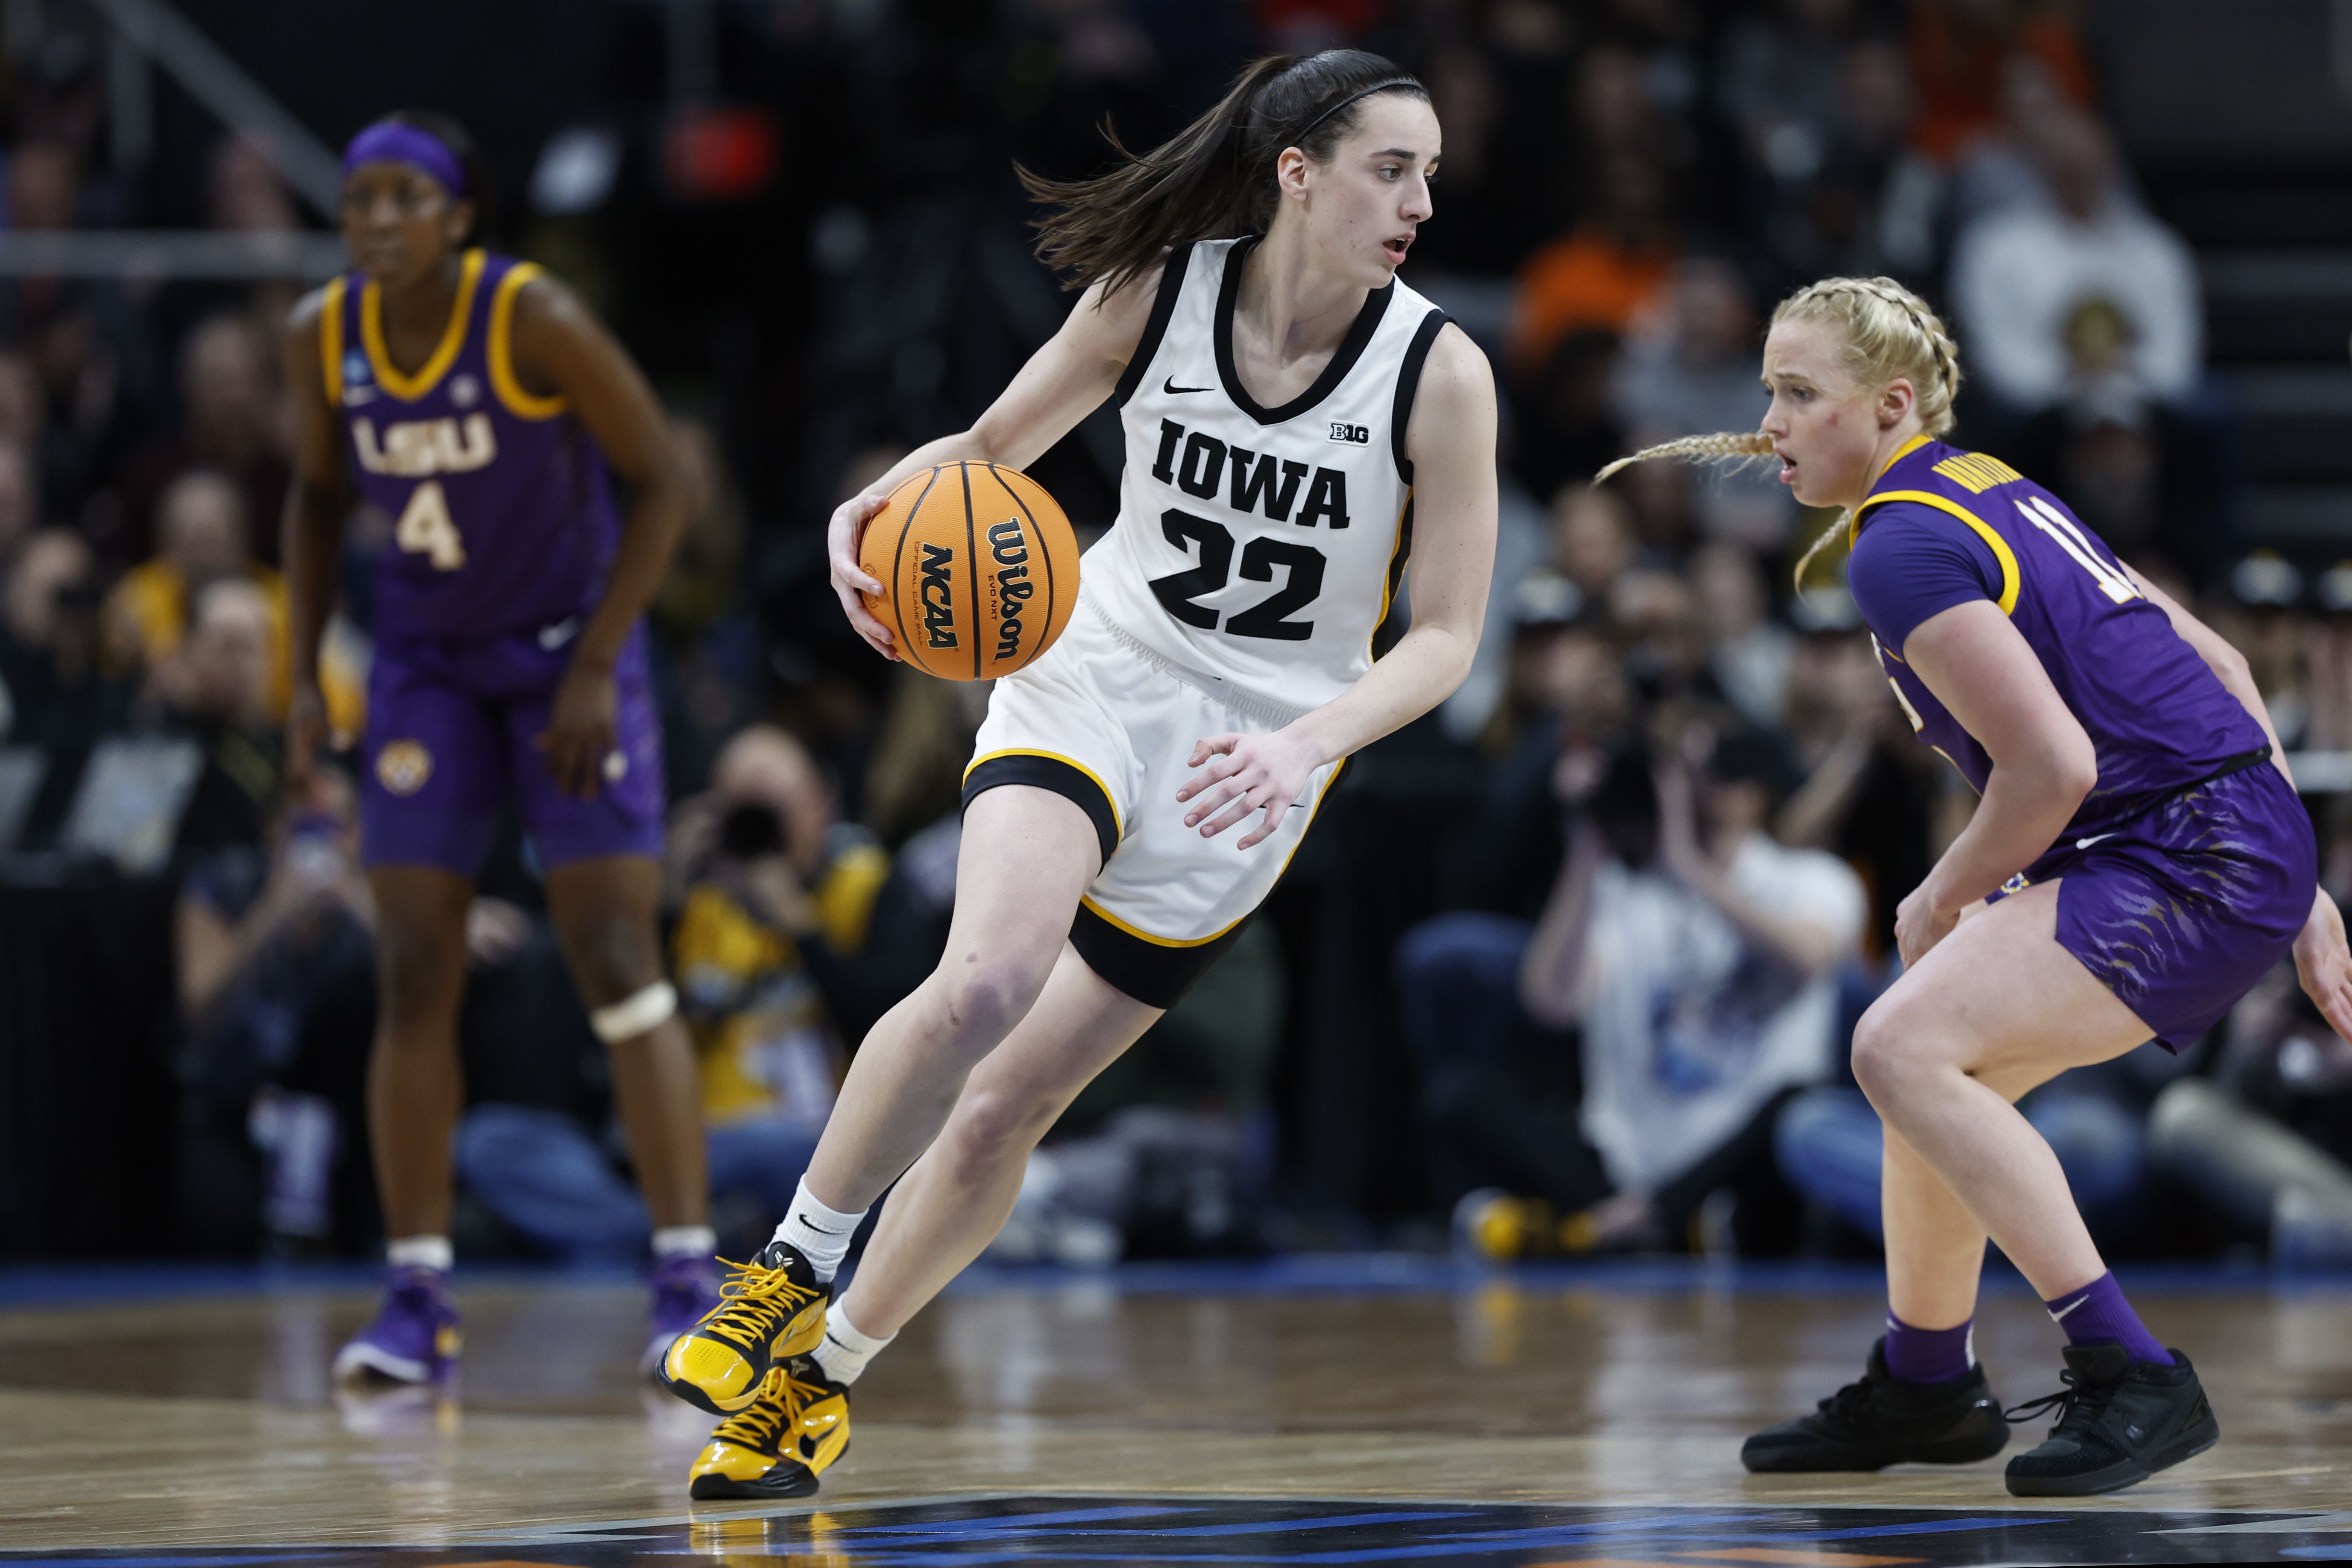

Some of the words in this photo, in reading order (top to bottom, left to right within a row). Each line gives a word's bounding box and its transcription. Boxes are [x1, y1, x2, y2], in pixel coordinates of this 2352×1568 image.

[396, 479, 467, 572] 4
[1152, 417, 1350, 529] IOWA
[921, 542, 959, 649] NCAA
[986, 517, 1034, 661] Wilson
[988, 575, 996, 597] EVO
[1148, 508, 1327, 641] 22
[916, 623, 924, 646] BALL
